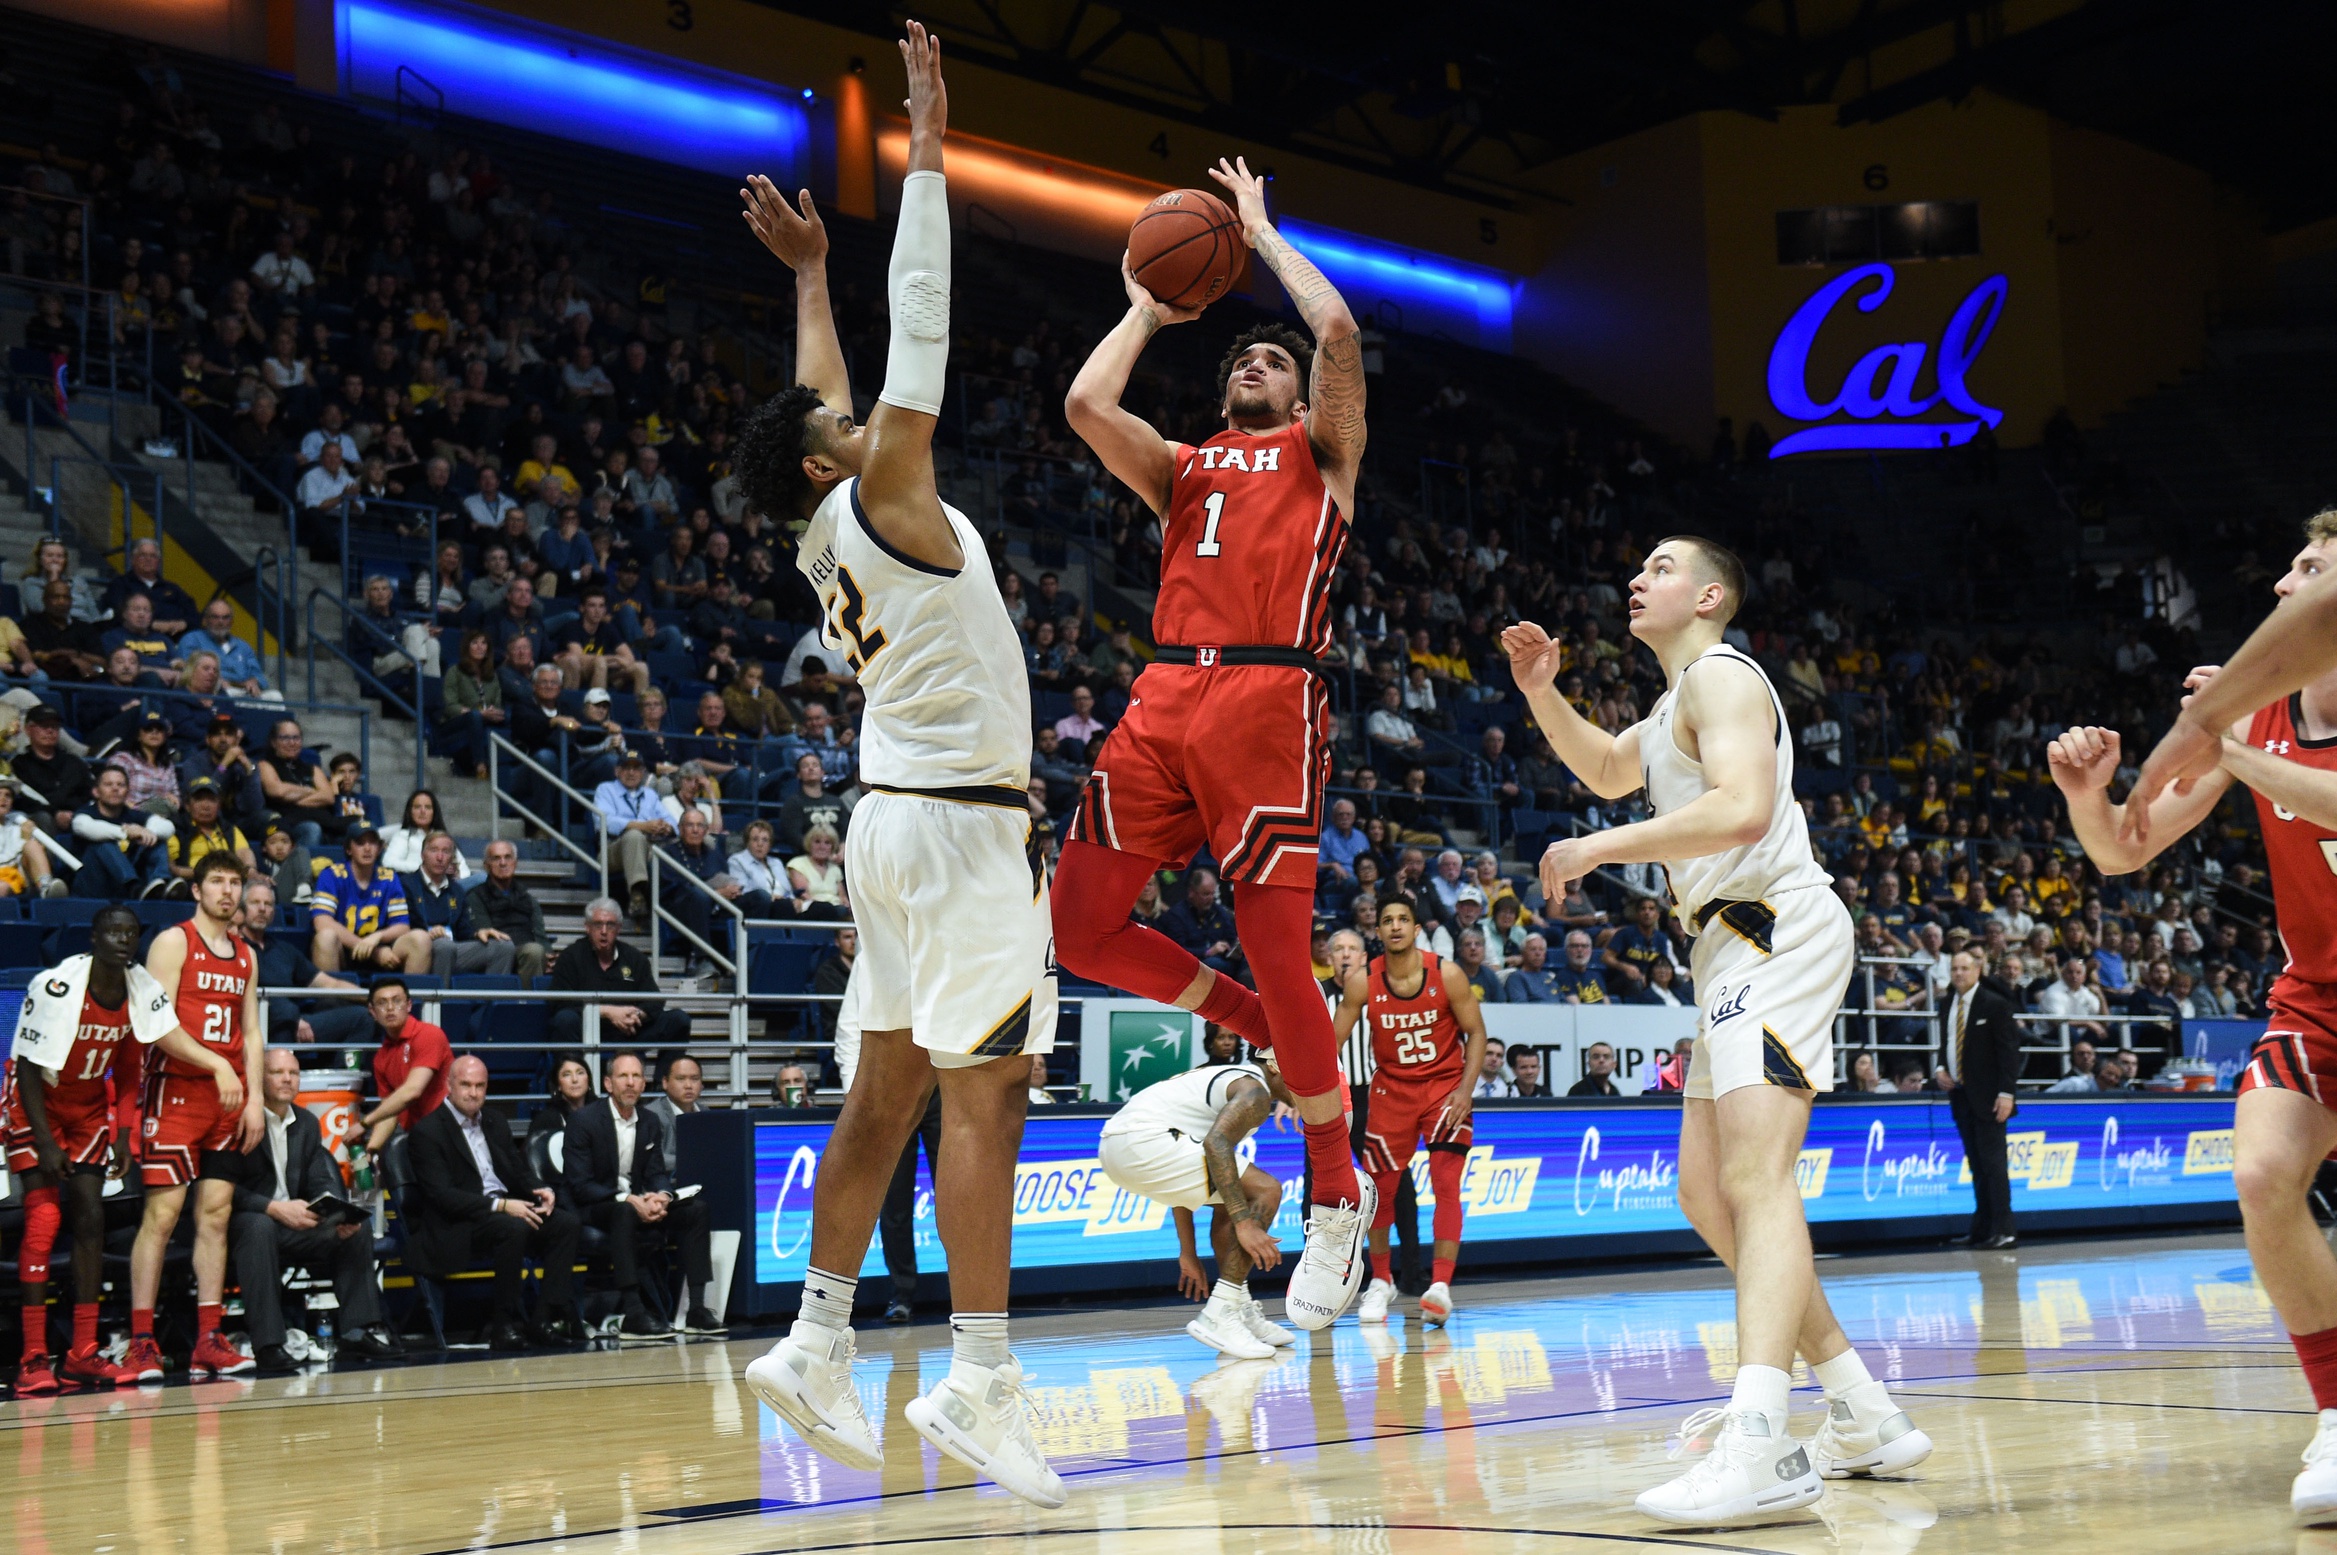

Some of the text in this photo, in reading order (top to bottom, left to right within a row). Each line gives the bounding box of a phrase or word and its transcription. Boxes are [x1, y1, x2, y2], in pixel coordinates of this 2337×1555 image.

[667, 0, 693, 32] 3
[1149, 132, 1168, 159] 4
[1862, 163, 1889, 191] 6
[1479, 218, 1498, 245] 5
[1767, 262, 2009, 460] Cal
[1192, 445, 1282, 473] TAH
[1196, 490, 1226, 558] 1
[808, 543, 837, 588] KELLY
[1199, 647, 1218, 668] U
[346, 904, 380, 937] 12
[197, 970, 246, 996] UTAH
[203, 1003, 232, 1044] 21
[1380, 1009, 1439, 1030] UTAH
[1710, 984, 1751, 1031] Cal
[1394, 1028, 1437, 1065] 25
[78, 1048, 113, 1080] 11
[326, 1106, 351, 1136] G
[1862, 1119, 1950, 1202] Cupcake
[2036, 1150, 2071, 1183] JOY
[2190, 1136, 2234, 1169] CHOO
[1478, 1166, 1530, 1207] JOY
[1574, 1126, 1675, 1217] Cupcake
[1795, 1157, 1822, 1190] OY
[1014, 1167, 1104, 1215] OOSE
